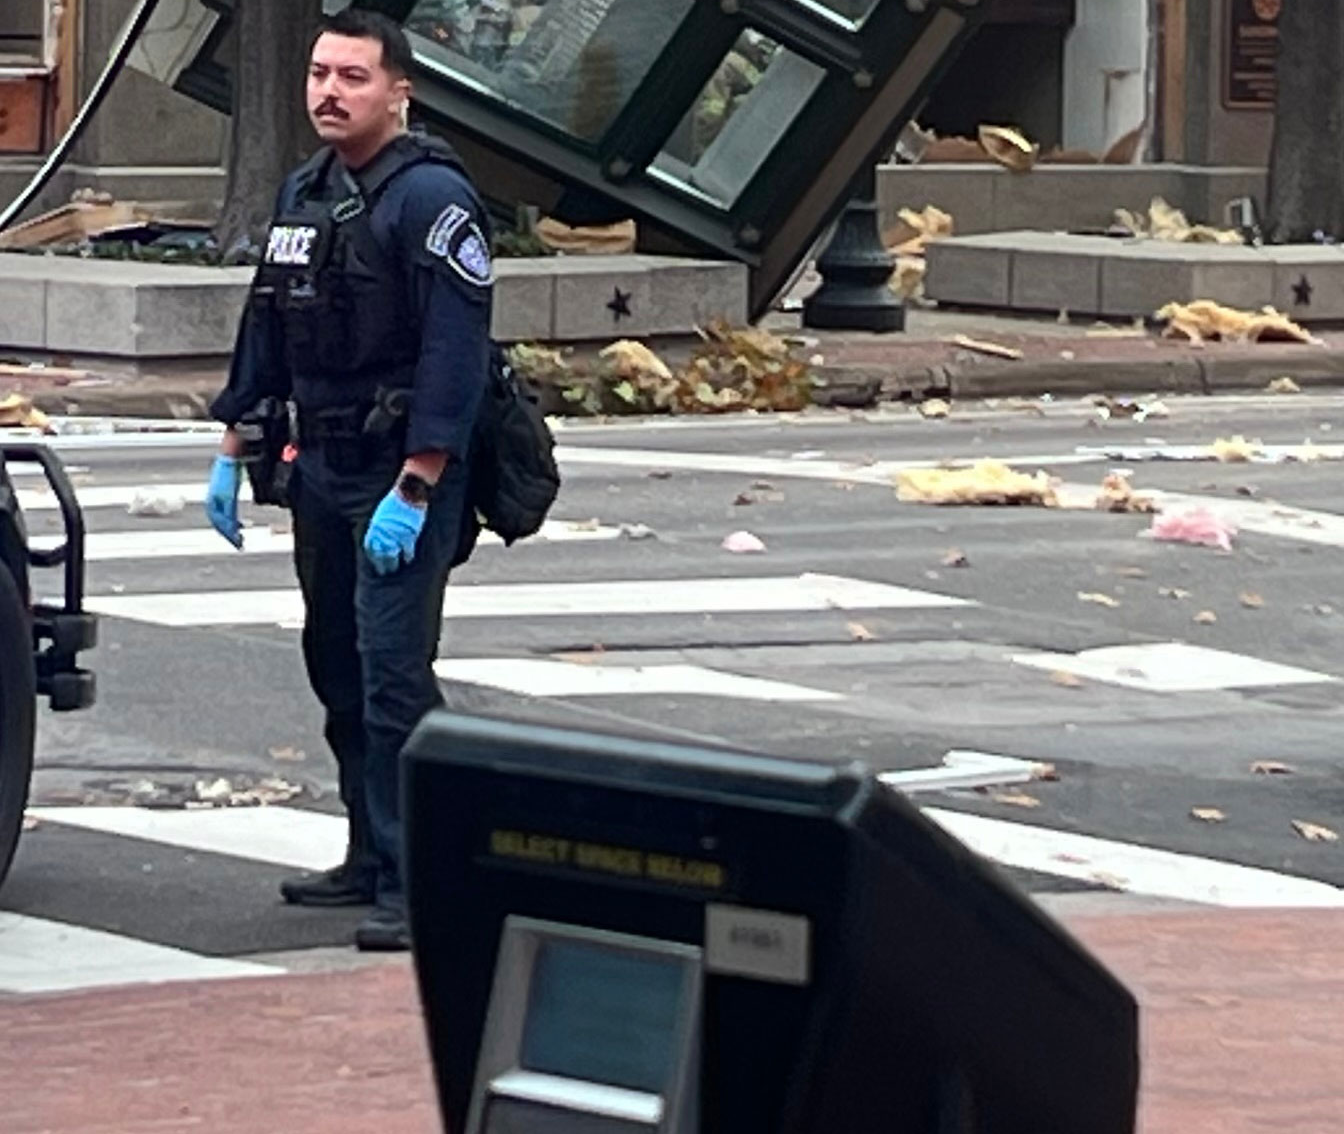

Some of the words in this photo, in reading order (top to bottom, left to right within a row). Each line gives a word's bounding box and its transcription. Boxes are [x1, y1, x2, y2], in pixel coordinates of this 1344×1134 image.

[265, 225, 318, 265] POLICE
[491, 829, 570, 864] SELECT
[574, 841, 643, 877] SPACE
[646, 852, 722, 888] BELOW
